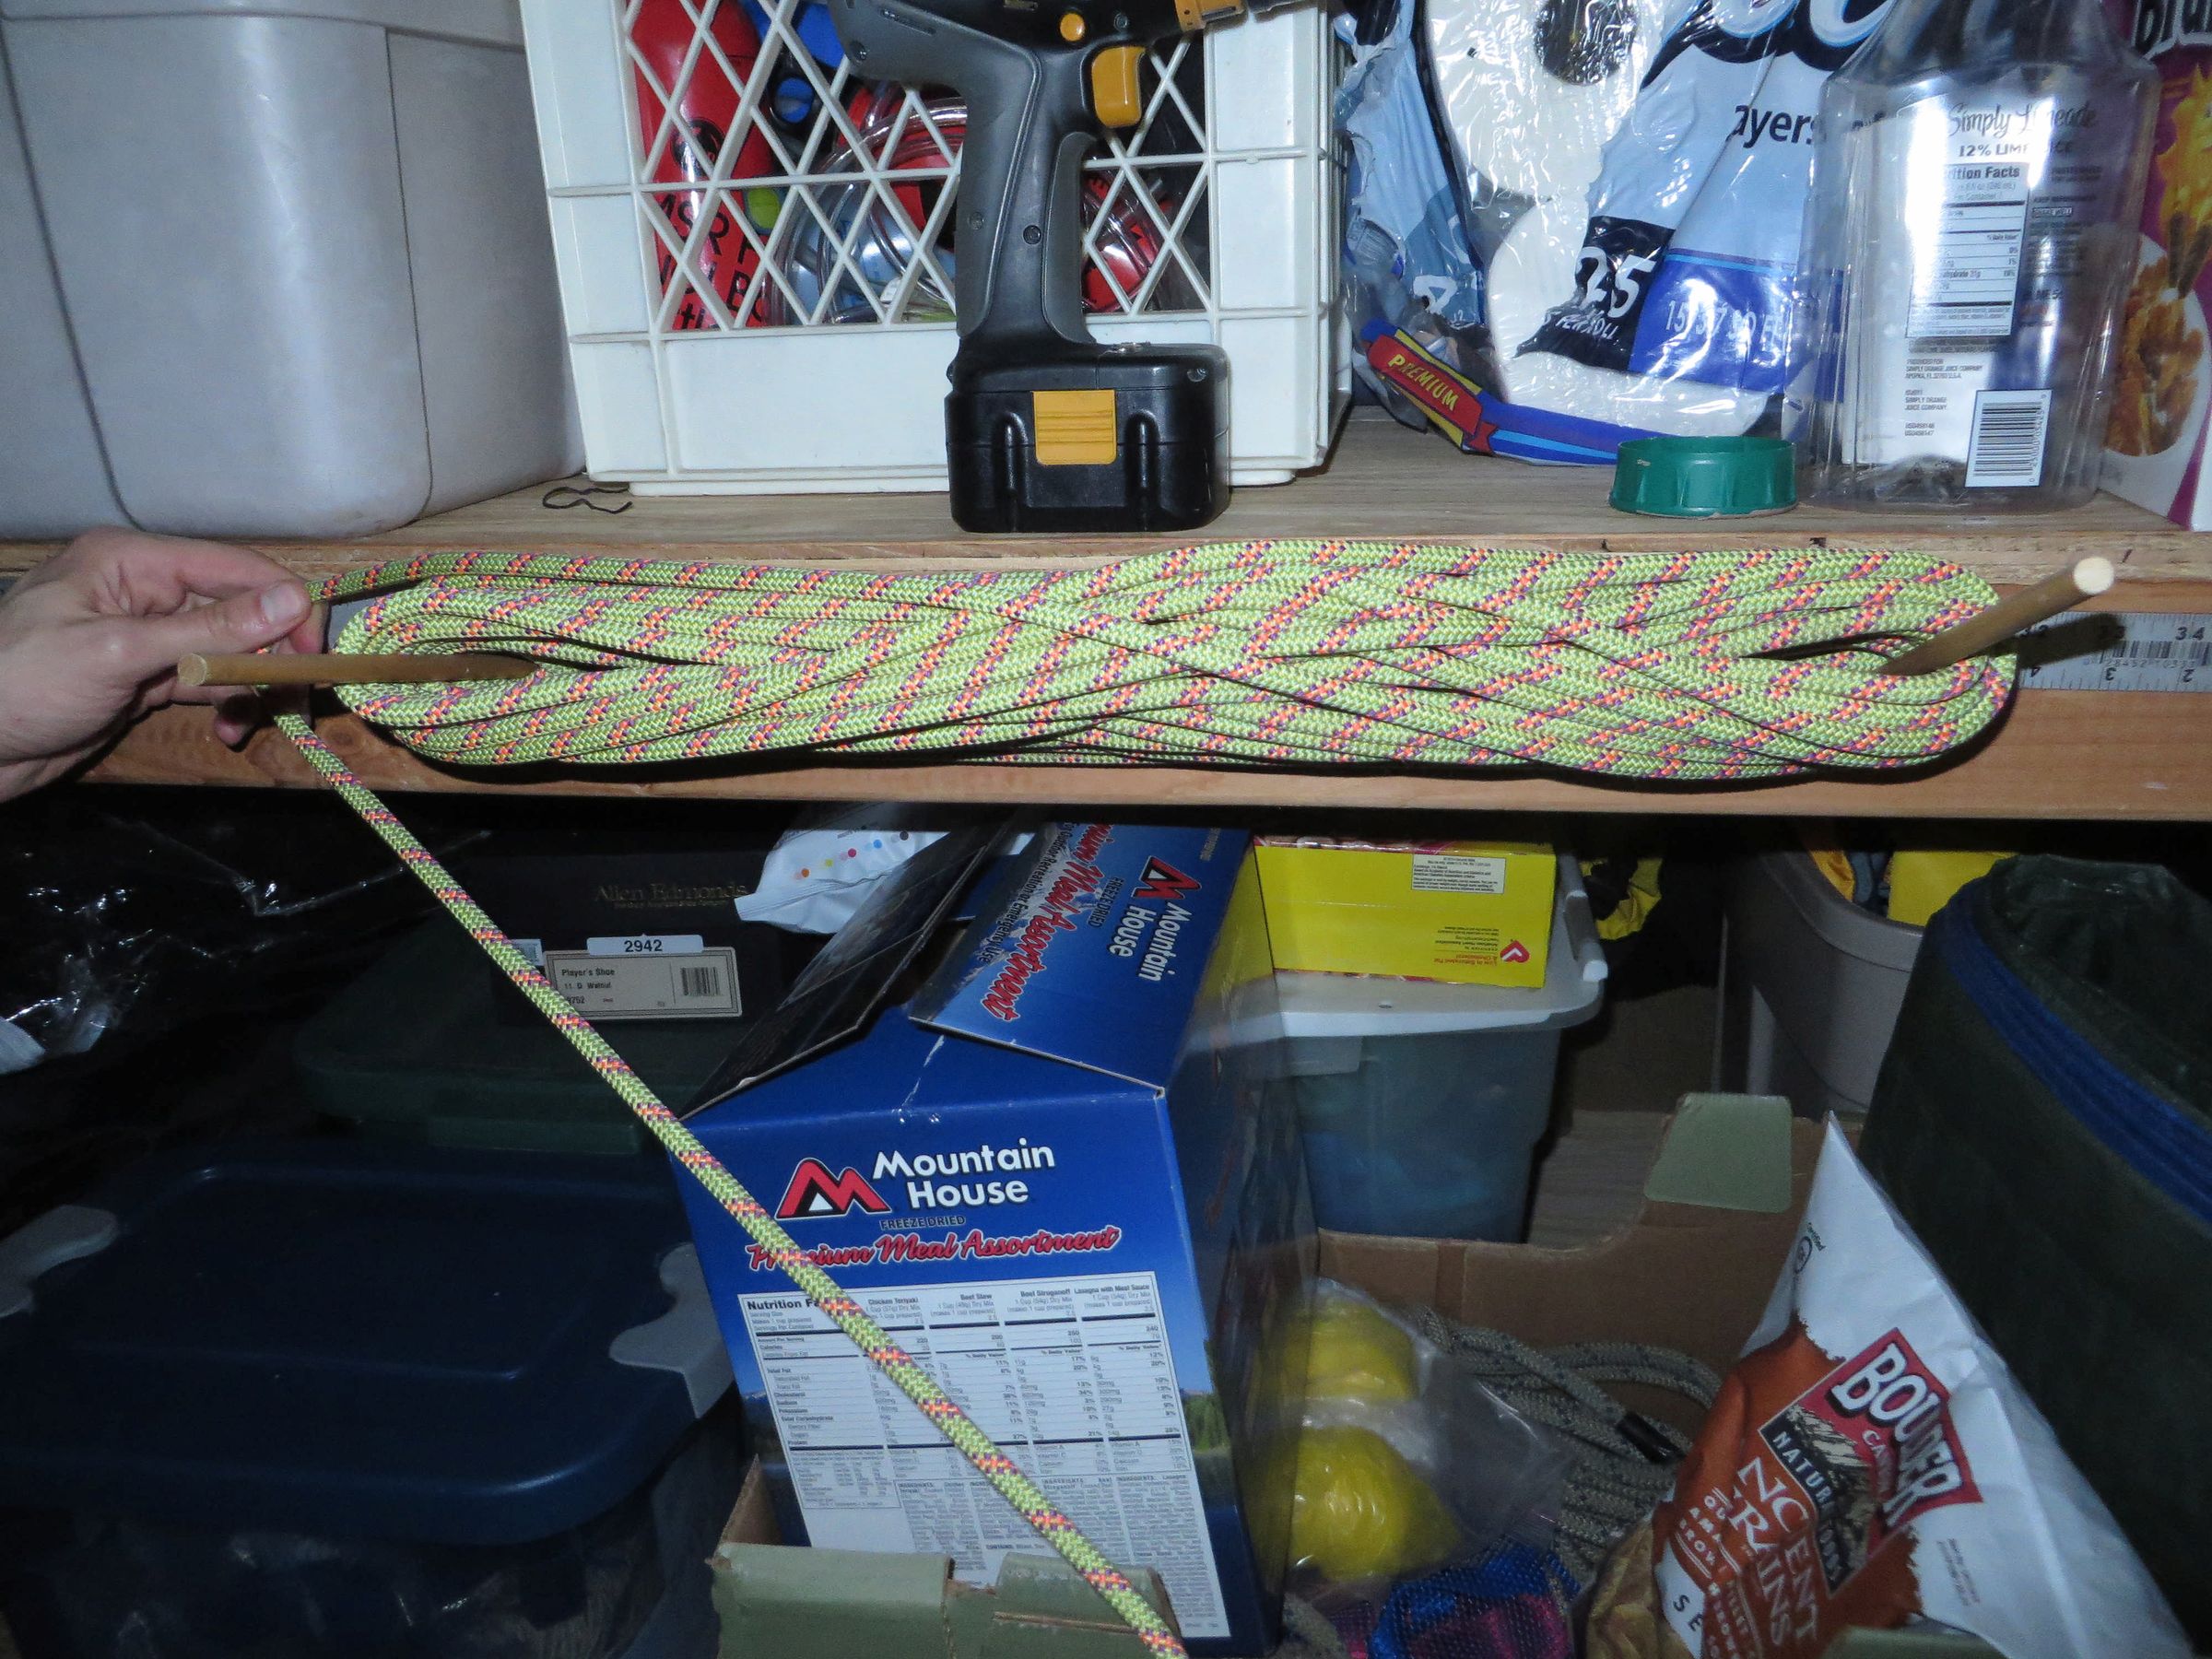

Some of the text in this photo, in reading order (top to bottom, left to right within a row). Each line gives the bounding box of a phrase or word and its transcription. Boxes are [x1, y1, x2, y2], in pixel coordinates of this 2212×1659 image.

[1949, 103, 2010, 138] Simply
[1959, 145, 1991, 157] 12%
[1985, 166, 2020, 178] Facts
[1387, 354, 1459, 411] PREMIUM
[624, 939, 663, 953] 2942
[1109, 905, 1158, 958] House
[1137, 901, 1192, 982] Mountain
[977, 945, 1003, 963] Use
[981, 904, 1077, 1022] Assortment
[873, 1137, 1055, 1180] Mountain
[906, 1177, 1030, 1209] House
[879, 1214, 967, 1230] FREEZE DRIED
[876, 1231, 959, 1264] Meal
[960, 1224, 1123, 1261] Assortment
[747, 1300, 802, 1311] Nutrition
